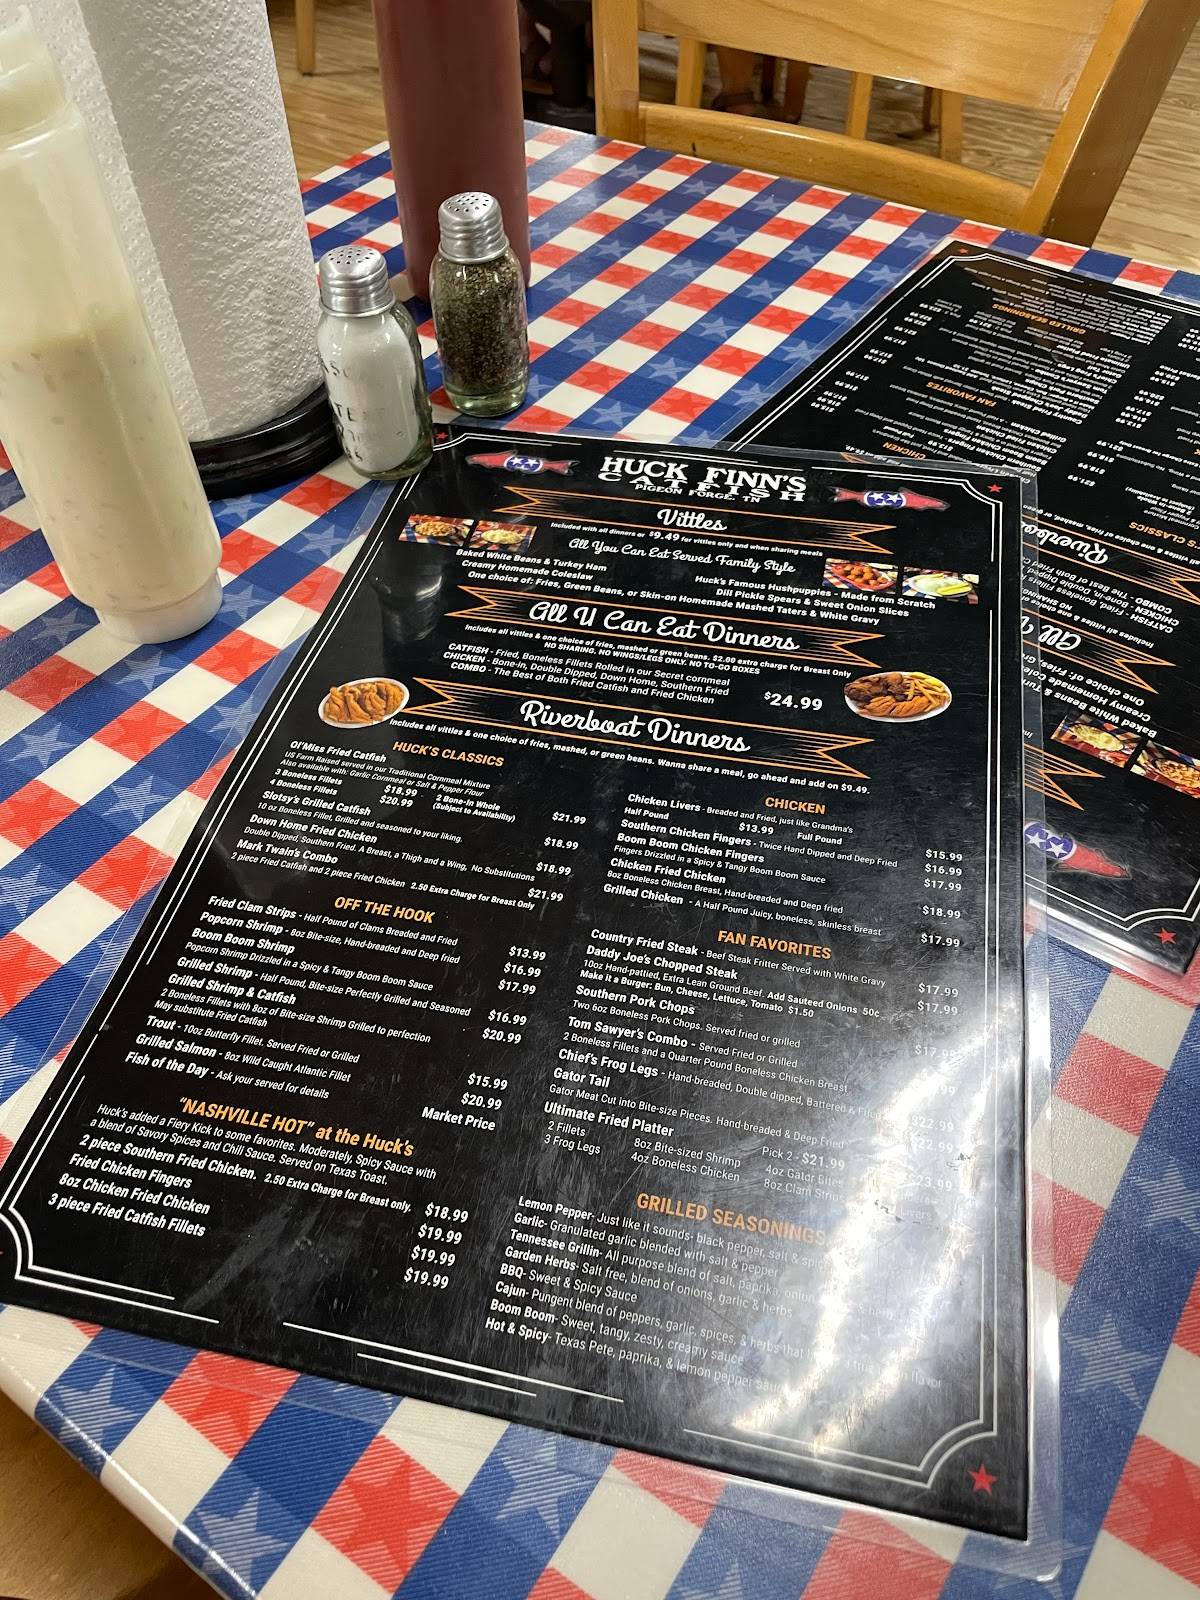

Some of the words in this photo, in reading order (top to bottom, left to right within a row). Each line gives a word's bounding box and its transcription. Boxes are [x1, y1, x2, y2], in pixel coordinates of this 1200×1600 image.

[991, 303, 1048, 323] SEASONINGS
[1048, 320, 1086, 334] GRILLED
[926, 381, 976, 400] FAVORITES
[976, 397, 996, 406] FAN
[882, 441, 926, 460] CHICKEN
[599, 456, 688, 481] HUCK
[704, 466, 806, 492] FINN'S
[656, 508, 727, 530] Vittles
[550, 522, 581, 530] Included
[608, 528, 635, 536] dinners
[648, 530, 680, 541] $9.49
[770, 546, 799, 555] sharing
[1022, 522, 1108, 564] Riverbo
[1128, 521, 1185, 543] CLASSICS
[455, 548, 485, 557] Baked
[486, 551, 512, 560] White
[513, 554, 542, 563] Beans
[543, 557, 550, 565] &
[552, 558, 584, 570] Turkey
[585, 562, 607, 571] Ham
[568, 537, 589, 549] All
[591, 540, 619, 554] You
[620, 543, 647, 556] Can
[648, 546, 671, 558] Eat
[672, 549, 713, 563] Served
[714, 554, 761, 572] Family
[763, 559, 796, 575] Style
[1030, 560, 1054, 573] Fried
[1055, 569, 1077, 581] Both
[1088, 580, 1110, 592] Best
[694, 575, 726, 585] Huck's
[728, 578, 765, 589] Famous
[767, 583, 831, 596] Hushpuppies
[840, 591, 868, 601] Made
[870, 594, 894, 604] from
[896, 597, 935, 609] Scratch
[1110, 588, 1127, 599] The
[1134, 597, 1172, 614] COMBO
[528, 600, 567, 623] All
[572, 606, 597, 626] U
[603, 609, 652, 633] Can
[655, 615, 701, 638] Eat
[702, 621, 800, 650] Dinners
[1037, 624, 1081, 650] All
[763, 690, 822, 710] $24.99
[519, 699, 645, 737] Riverboat
[647, 717, 750, 752] Dinners
[325, 745, 352, 756] Fried
[352, 750, 386, 762] Catfish
[392, 741, 439, 756] HUCK'S
[441, 748, 504, 766] CLASSICS
[261, 790, 300, 804] Slotsy's
[301, 796, 335, 809] Grilled
[335, 802, 371, 815] Catfish
[764, 796, 825, 814] CHICKEN
[551, 811, 586, 824] $21.99
[236, 838, 263, 851] Mark
[265, 843, 301, 857] Twain's
[302, 849, 338, 863] Combo
[616, 832, 646, 844] Boom
[648, 837, 678, 850] Boom
[680, 842, 722, 856] Chicken
[724, 848, 764, 862] Fingers
[613, 844, 642, 855] Fingers
[643, 849, 676, 860] Drizzled
[676, 854, 684, 862] in
[693, 857, 715, 868] Spicy
[724, 861, 748, 873] Tangy
[749, 865, 773, 875] Boom
[774, 869, 798, 879] Boom
[800, 873, 826, 883] Sauce
[923, 878, 961, 891] $17.99
[334, 896, 362, 910] OFF
[364, 900, 392, 916] THE
[392, 905, 435, 923] HOOK
[191, 927, 222, 941] Boom
[223, 932, 255, 947] Boom
[256, 938, 295, 955] Shrimp
[717, 929, 746, 945] FAN
[749, 935, 831, 959] FAVORITES
[575, 984, 626, 1002] Southern
[629, 993, 656, 1008] Pork
[658, 999, 695, 1015] Chops
[124, 1051, 150, 1065] Fish
[151, 1056, 167, 1068] of
[165, 1058, 185, 1071] the
[185, 1062, 209, 1078] Day
[214, 1070, 233, 1081] Ask
[232, 1074, 254, 1084] your
[254, 1078, 285, 1090] served
[284, 1082, 299, 1092] for
[299, 1085, 329, 1098] details
[421, 1106, 463, 1124] Market
[464, 1114, 495, 1130] Price
[315, 1126, 332, 1140] at
[334, 1127, 360, 1145] the
[68, 1152, 101, 1169] Fried
[100, 1159, 147, 1179] Chicken
[147, 1168, 192, 1188] Fingers
[636, 1192, 707, 1220] GRILLED
[417, 1223, 462, 1244] $19.99
[499, 1262, 526, 1279] BBQ-
[528, 1268, 561, 1286] Sweet
[562, 1276, 570, 1288] &
[573, 1278, 602, 1298] Spicy
[604, 1285, 637, 1302] Sauce
